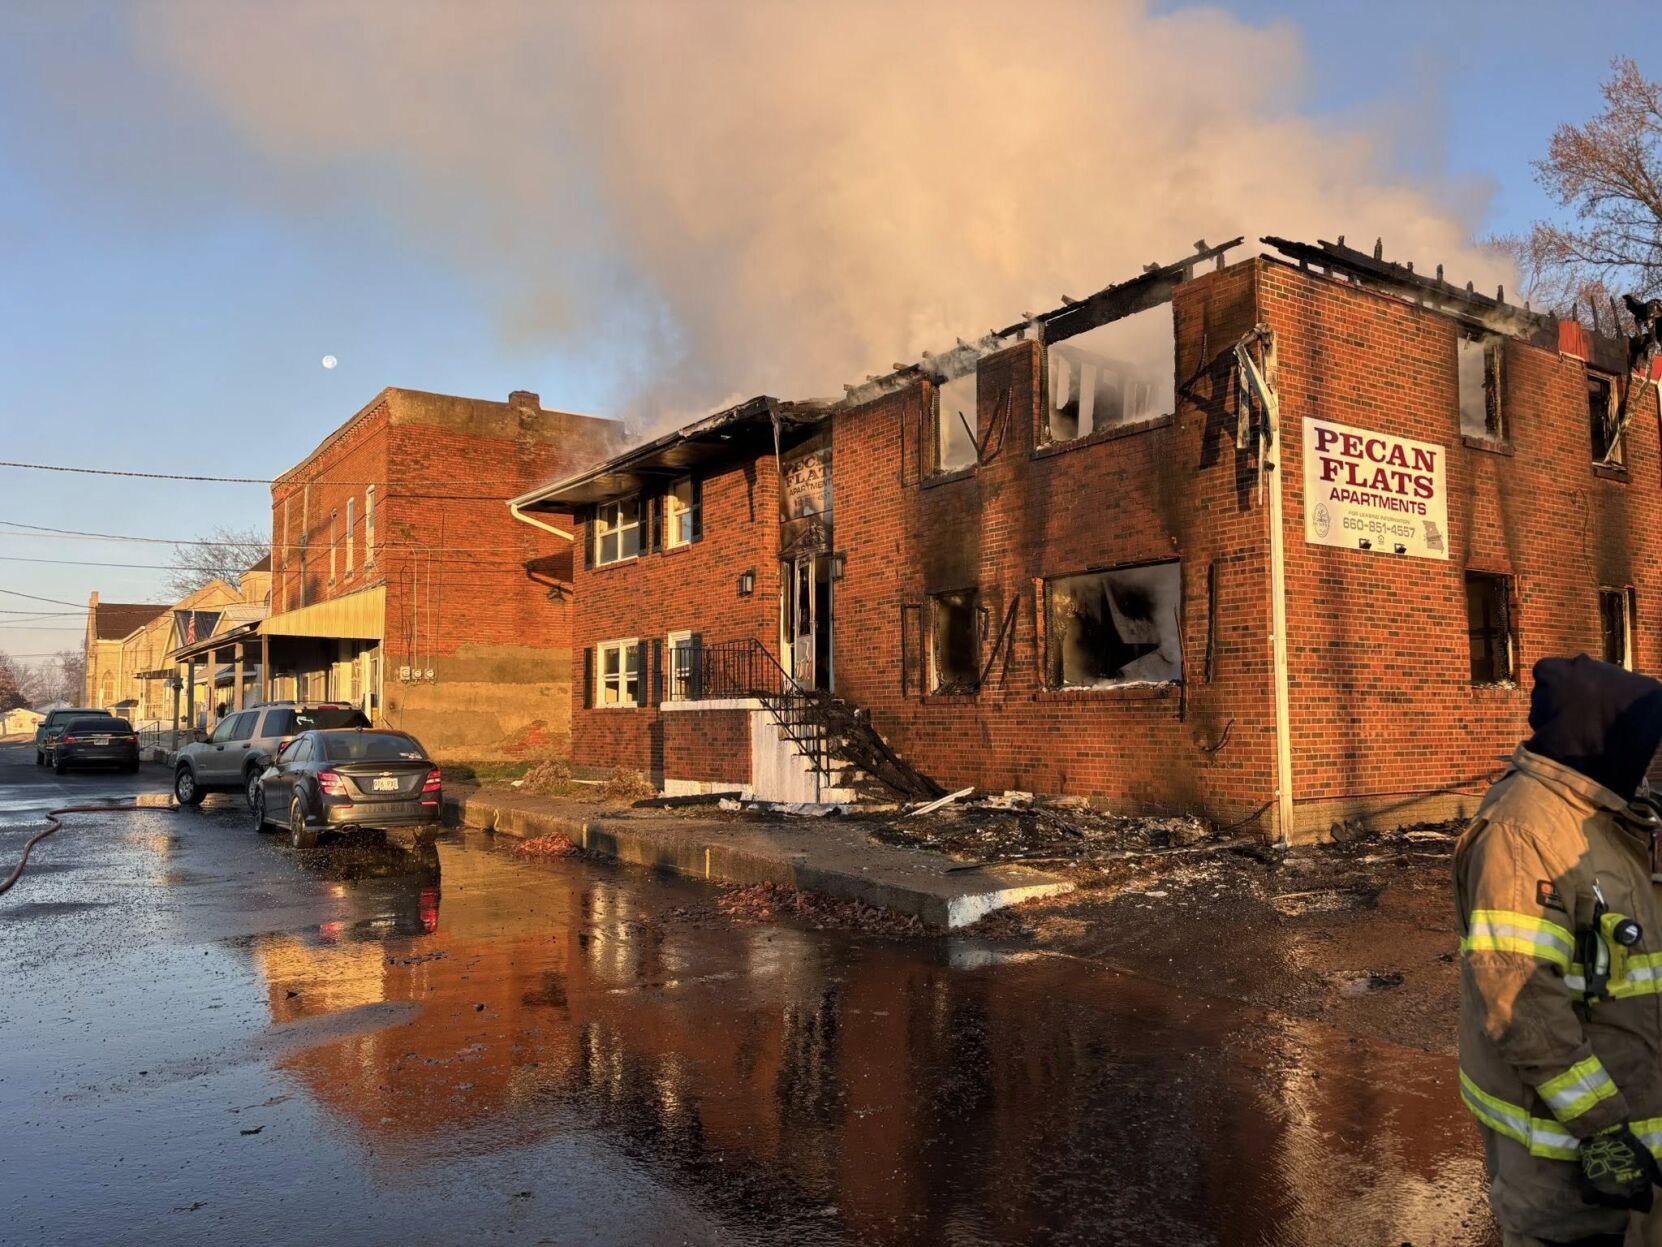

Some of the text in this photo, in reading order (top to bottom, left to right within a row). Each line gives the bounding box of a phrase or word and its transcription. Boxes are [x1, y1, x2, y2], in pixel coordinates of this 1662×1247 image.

[1313, 427, 1437, 473] PECAN
[1319, 456, 1434, 500] FLATS
[1329, 487, 1427, 516] APARTMENTS
[1342, 517, 1416, 539] 660-851-4557
